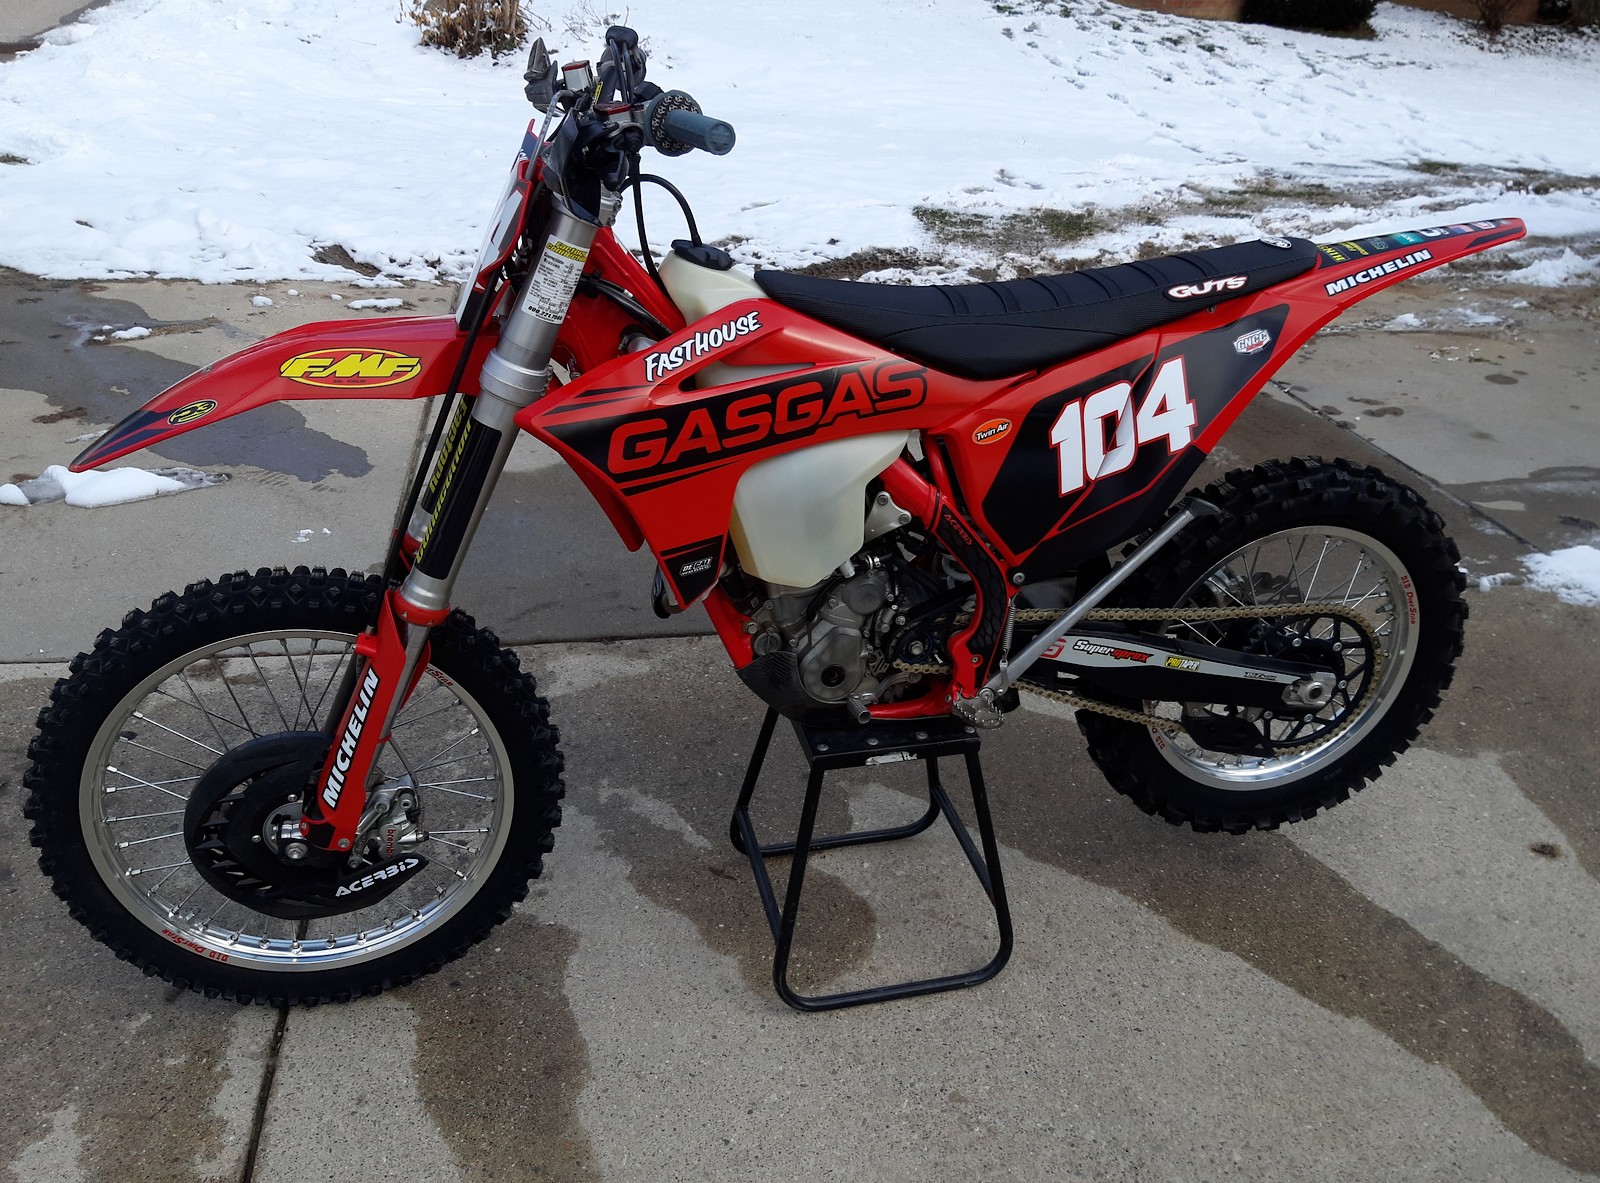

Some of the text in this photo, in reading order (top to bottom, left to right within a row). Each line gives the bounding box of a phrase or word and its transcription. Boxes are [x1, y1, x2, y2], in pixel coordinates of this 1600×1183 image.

[1325, 249, 1432, 296] MICHELIN
[1168, 276, 1248, 298] GUTS
[644, 311, 762, 381] FASTHOUSE
[1237, 332, 1267, 350] GNCC
[280, 353, 422, 377] FMF
[607, 361, 928, 474] GASGAS
[976, 422, 1010, 441] Twin Air
[1050, 356, 1197, 497] 104
[943, 514, 973, 546] ACERBIS
[1073, 639, 1154, 663] Supersprox
[322, 667, 380, 809] MICHELIN
[209, 950, 230, 963] DID
